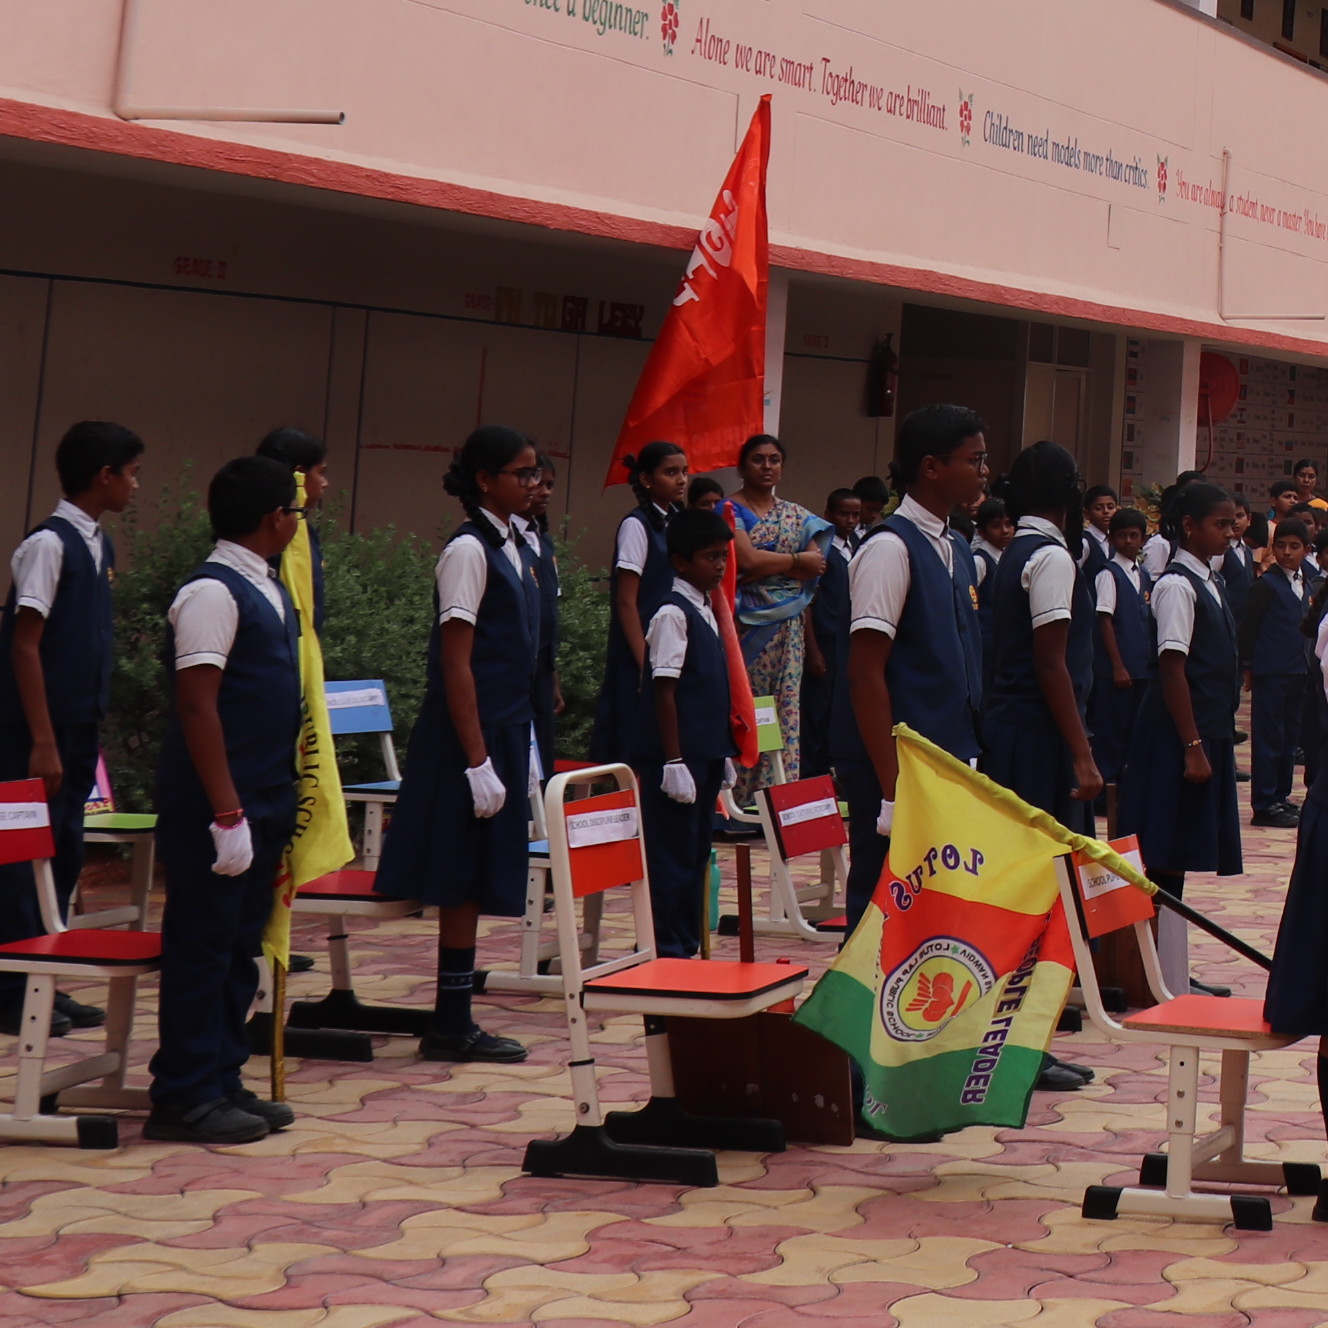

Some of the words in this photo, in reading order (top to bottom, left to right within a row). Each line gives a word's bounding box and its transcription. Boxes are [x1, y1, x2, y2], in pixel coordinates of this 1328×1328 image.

[691, 16, 731, 66] Alone
[734, 41, 753, 73] we
[754, 51, 777, 80] are
[777, 56, 817, 93] smart.
[819, 56, 868, 107] Together
[868, 83, 882, 112] we
[886, 90, 905, 118] are
[905, 84, 949, 132] brilliant.
[983, 110, 1025, 154] Children
[1026, 128, 1049, 161] need
[1051, 136, 1082, 172] models
[1082, 149, 1104, 177] more
[1105, 148, 1124, 183] than
[1123, 154, 1151, 190] critics.
[1175, 168, 1191, 200] You
[570, 820, 590, 830] SCHOOL
[1086, 875, 1107, 889] SCHOOL
